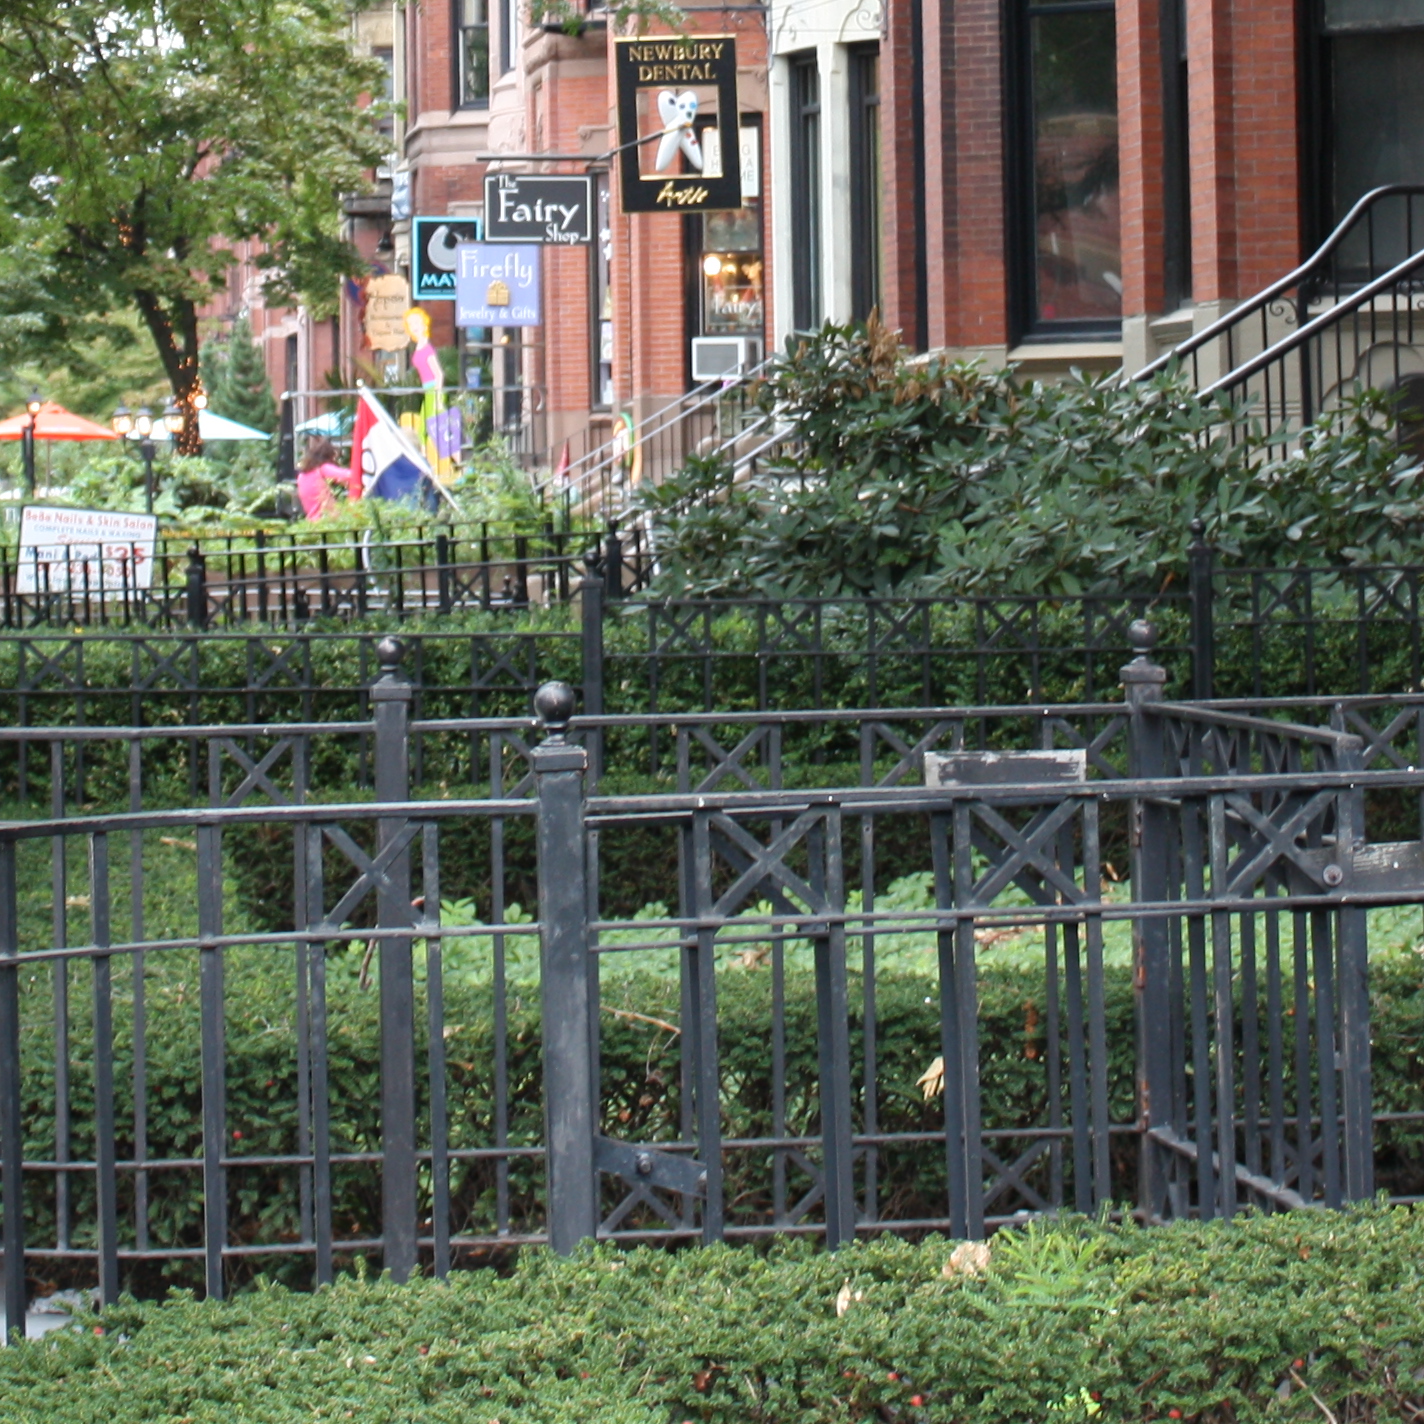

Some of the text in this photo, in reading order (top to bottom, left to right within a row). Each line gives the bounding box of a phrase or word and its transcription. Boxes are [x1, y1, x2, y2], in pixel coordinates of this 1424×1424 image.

[628, 43, 723, 62] NEWBURY
[638, 63, 716, 82] DENTAL
[496, 175, 517, 188] The
[497, 189, 580, 230] Fairy
[545, 223, 579, 245] Shop
[461, 249, 533, 288] Firefly
[460, 306, 536, 322] Jewelry & Gifts
[54, 512, 83, 525] Nails
[97, 515, 120, 528] Skin
[123, 518, 154, 530] Salon
